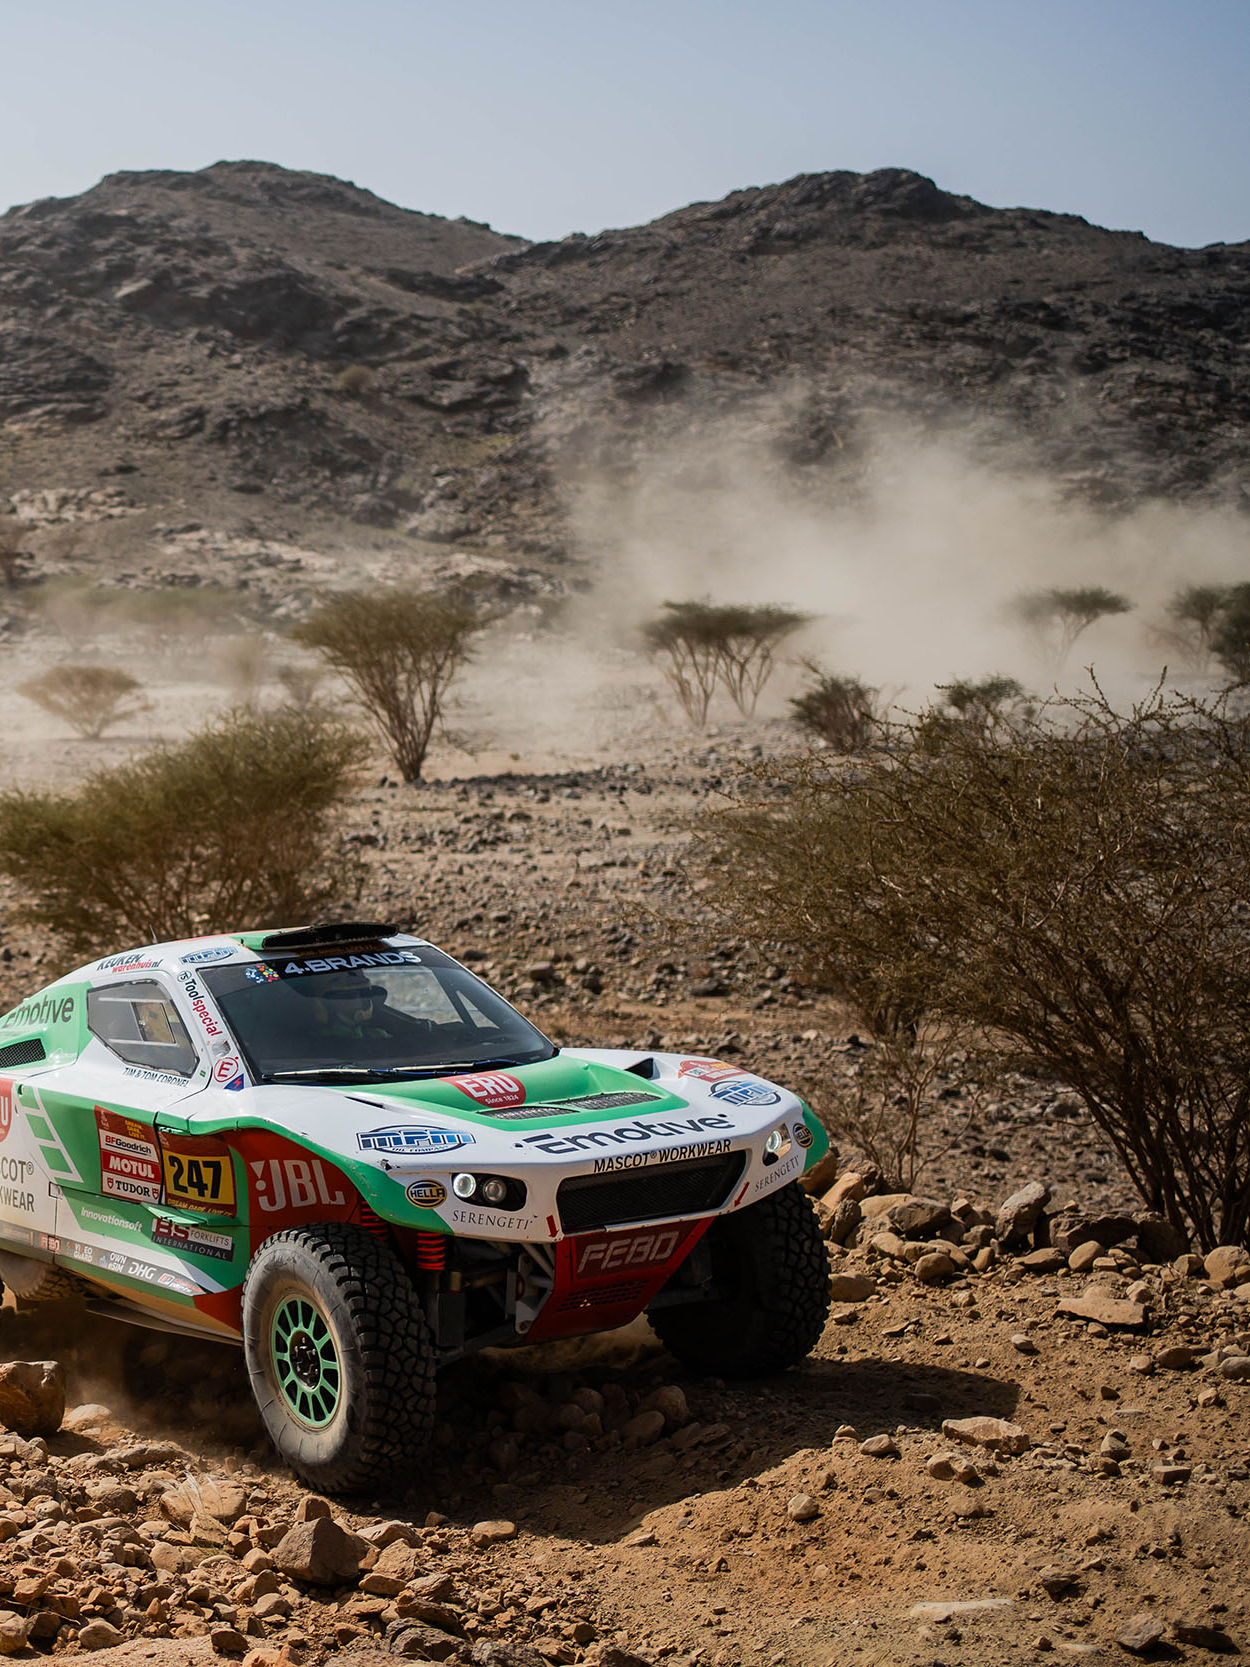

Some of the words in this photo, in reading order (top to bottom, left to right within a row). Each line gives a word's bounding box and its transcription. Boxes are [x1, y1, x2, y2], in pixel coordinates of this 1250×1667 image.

[96, 953, 145, 971] KEUKEN
[2, 995, 74, 1028] Emotive
[185, 978, 223, 1037] Toolspecial
[123, 1067, 136, 1076] TIM
[141, 1070, 158, 1081] TOM
[156, 1073, 190, 1088] CORONEL
[455, 1074, 519, 1098] ERU
[105, 1135, 152, 1154] BFGoodrich
[522, 1117, 736, 1155] Emotive
[659, 1139, 732, 1162] WORKWEAR
[109, 1155, 155, 1179] MOTUL
[168, 1155, 222, 1199] 247
[116, 1180, 151, 1197] TUDOR
[258, 1159, 346, 1212] JBL
[410, 1188, 446, 1198] HELLA
[453, 1210, 531, 1230] SERENGETI
[153, 1235, 227, 1260] INTERNATIONAL
[190, 1229, 230, 1247] FORKLIFTS
[110, 1252, 127, 1264] OWN
[577, 1231, 680, 1273] FEBO
[128, 1261, 157, 1280] DHG
